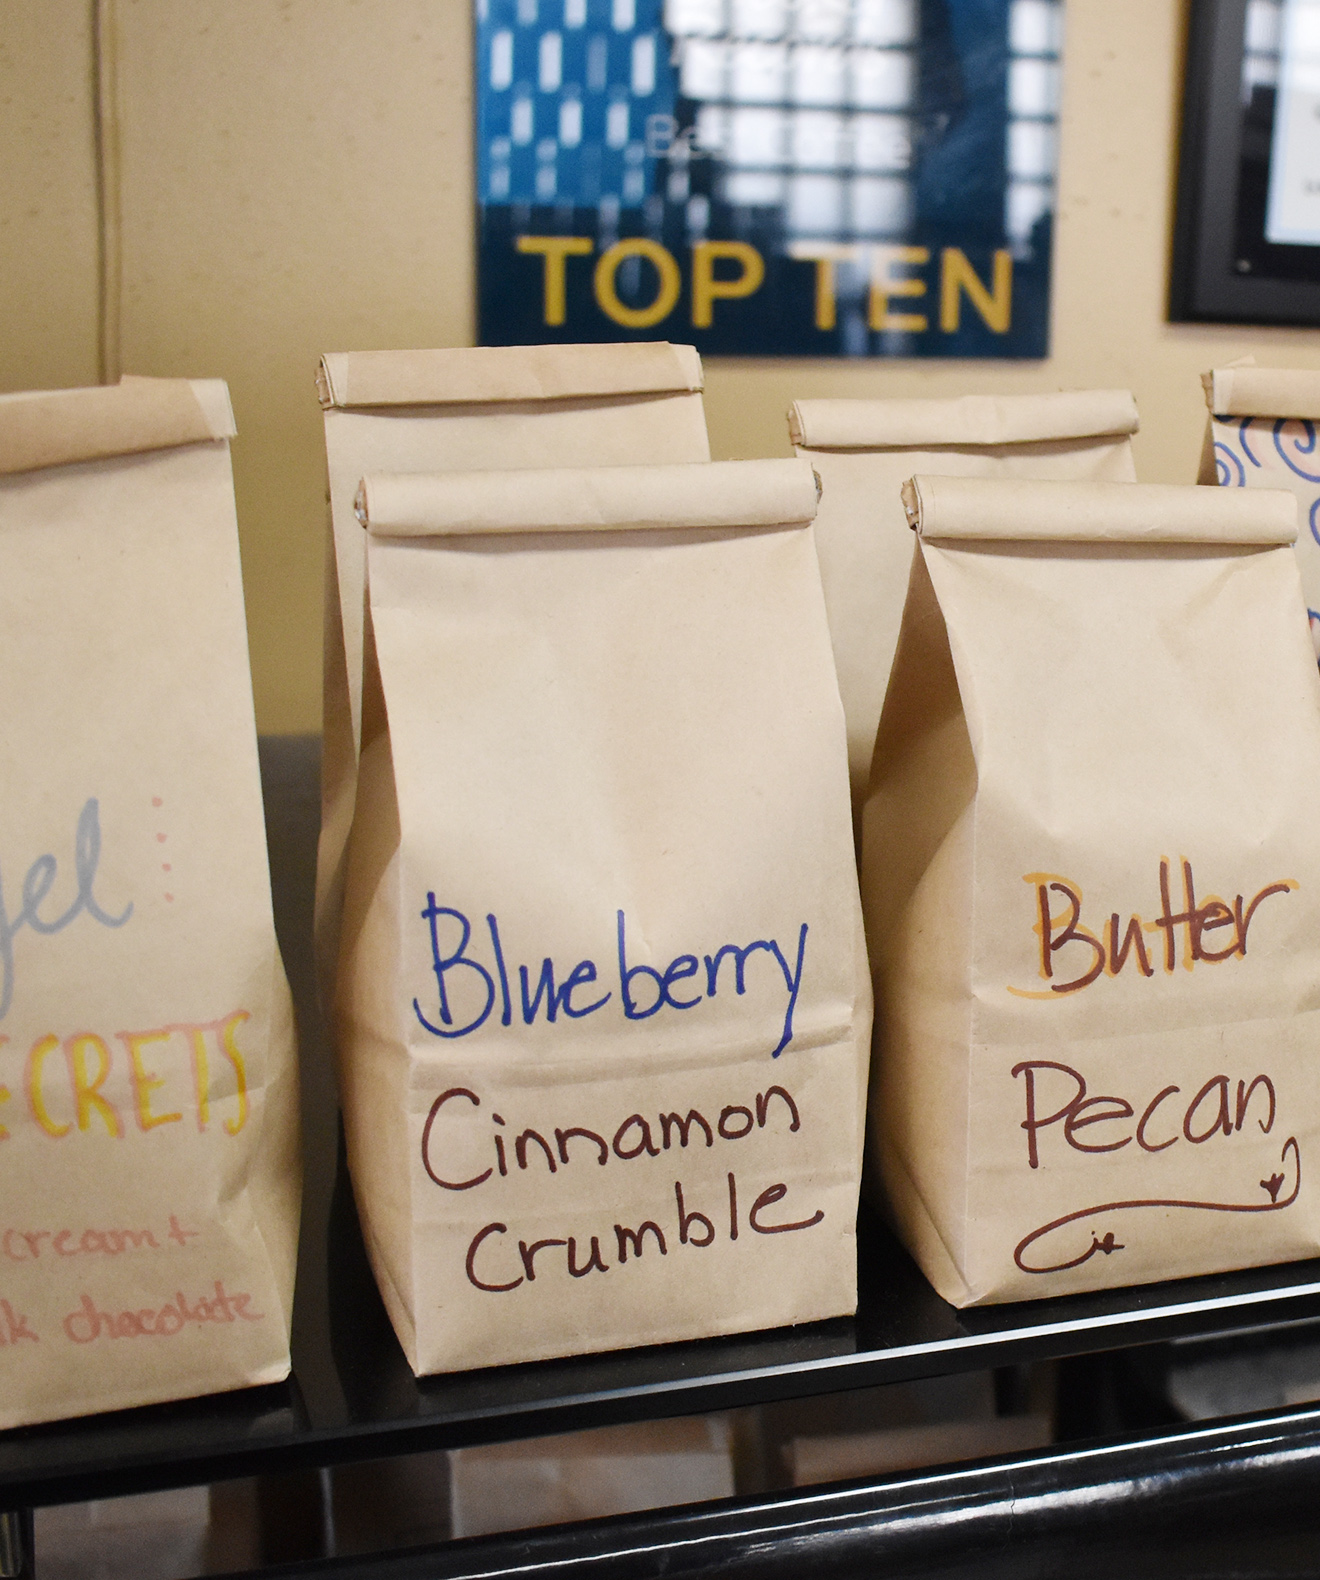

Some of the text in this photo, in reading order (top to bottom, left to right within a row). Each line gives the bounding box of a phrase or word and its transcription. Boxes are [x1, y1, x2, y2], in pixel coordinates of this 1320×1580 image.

[516, 236, 1013, 334] TOP TEN
[0, 796, 134, 1020] el
[1006, 855, 1299, 999] Butter
[412, 890, 809, 1059] Blueberry
[0, 1008, 251, 1141] CRETS
[1011, 1060, 1277, 1169] Pecan
[421, 1085, 801, 1191] Cinnamon
[62, 1279, 266, 1343] chocolate
